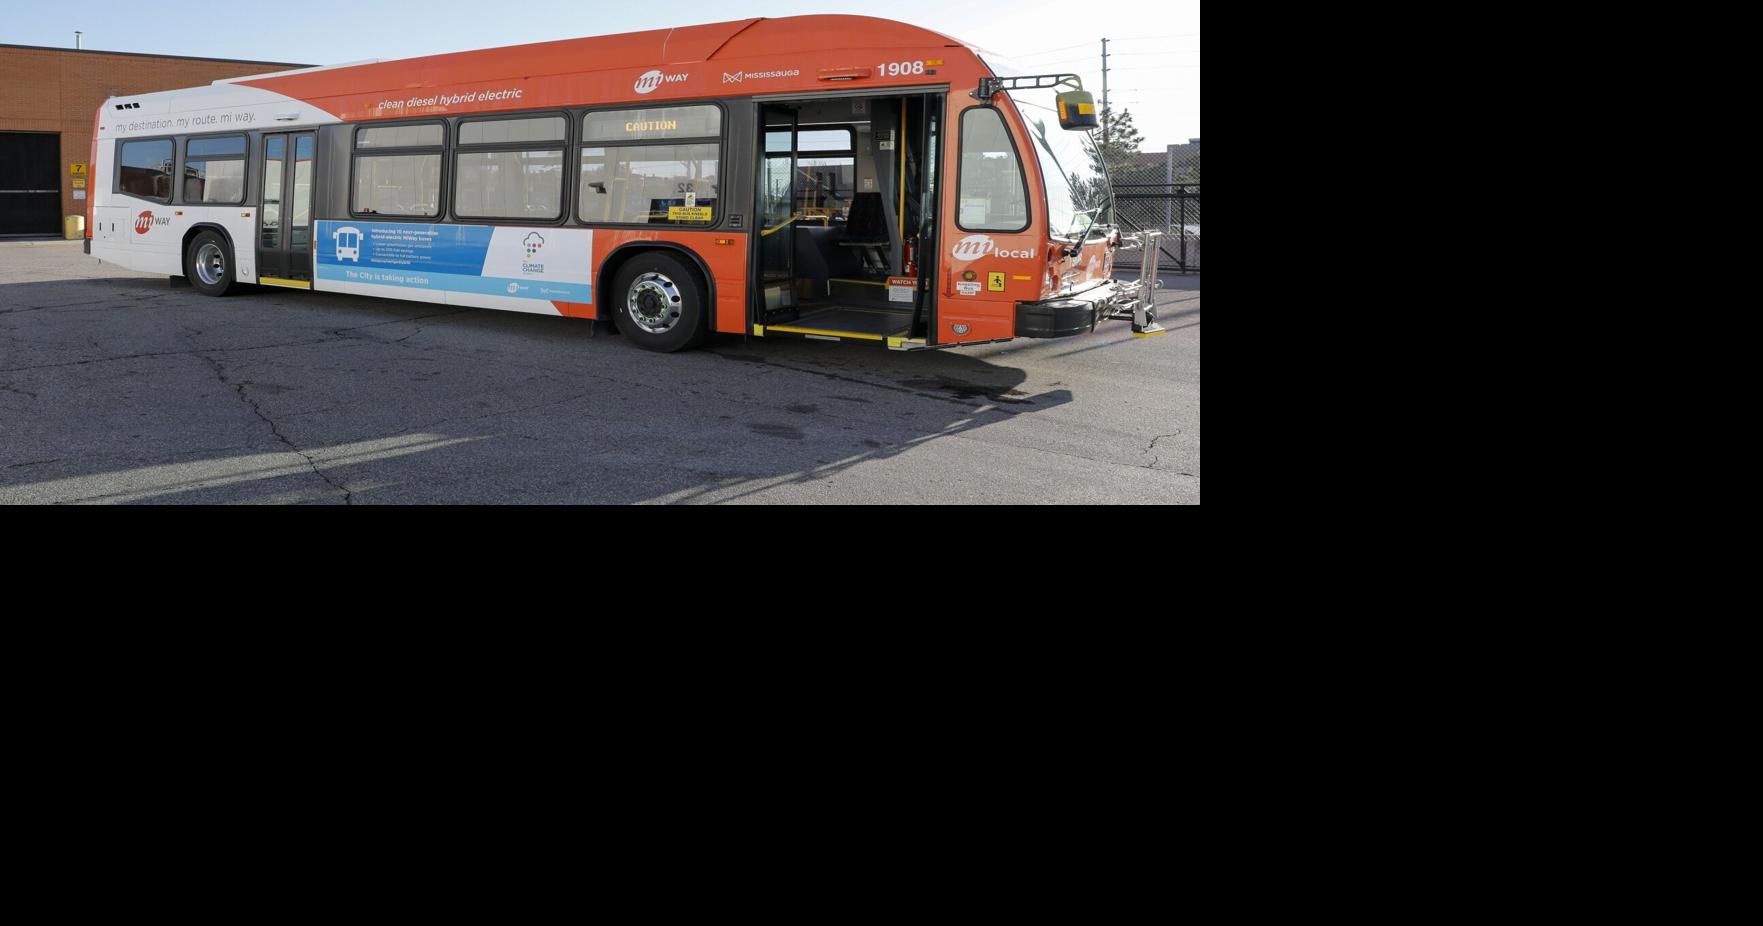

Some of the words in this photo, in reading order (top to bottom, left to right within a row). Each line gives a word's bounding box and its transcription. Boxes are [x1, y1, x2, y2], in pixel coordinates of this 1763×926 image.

[877, 60, 924, 77] 1908
[665, 73, 689, 83] WAY
[378, 99, 404, 110] clean
[407, 95, 438, 108] diesel
[439, 92, 476, 105] hybrid
[478, 88, 523, 101] electric
[115, 123, 127, 134] my
[128, 119, 174, 131] destination.
[176, 118, 191, 128] my
[192, 115, 218, 126] route.
[220, 112, 232, 123] mi
[235, 112, 256, 123] way.
[625, 121, 677, 132] CAUTION
[75, 164, 82, 172] 7
[155, 216, 171, 226] WAY
[994, 247, 1034, 259] local
[345, 270, 358, 278] The
[359, 272, 374, 281] City
[382, 274, 404, 284] taking
[405, 276, 429, 285] action
